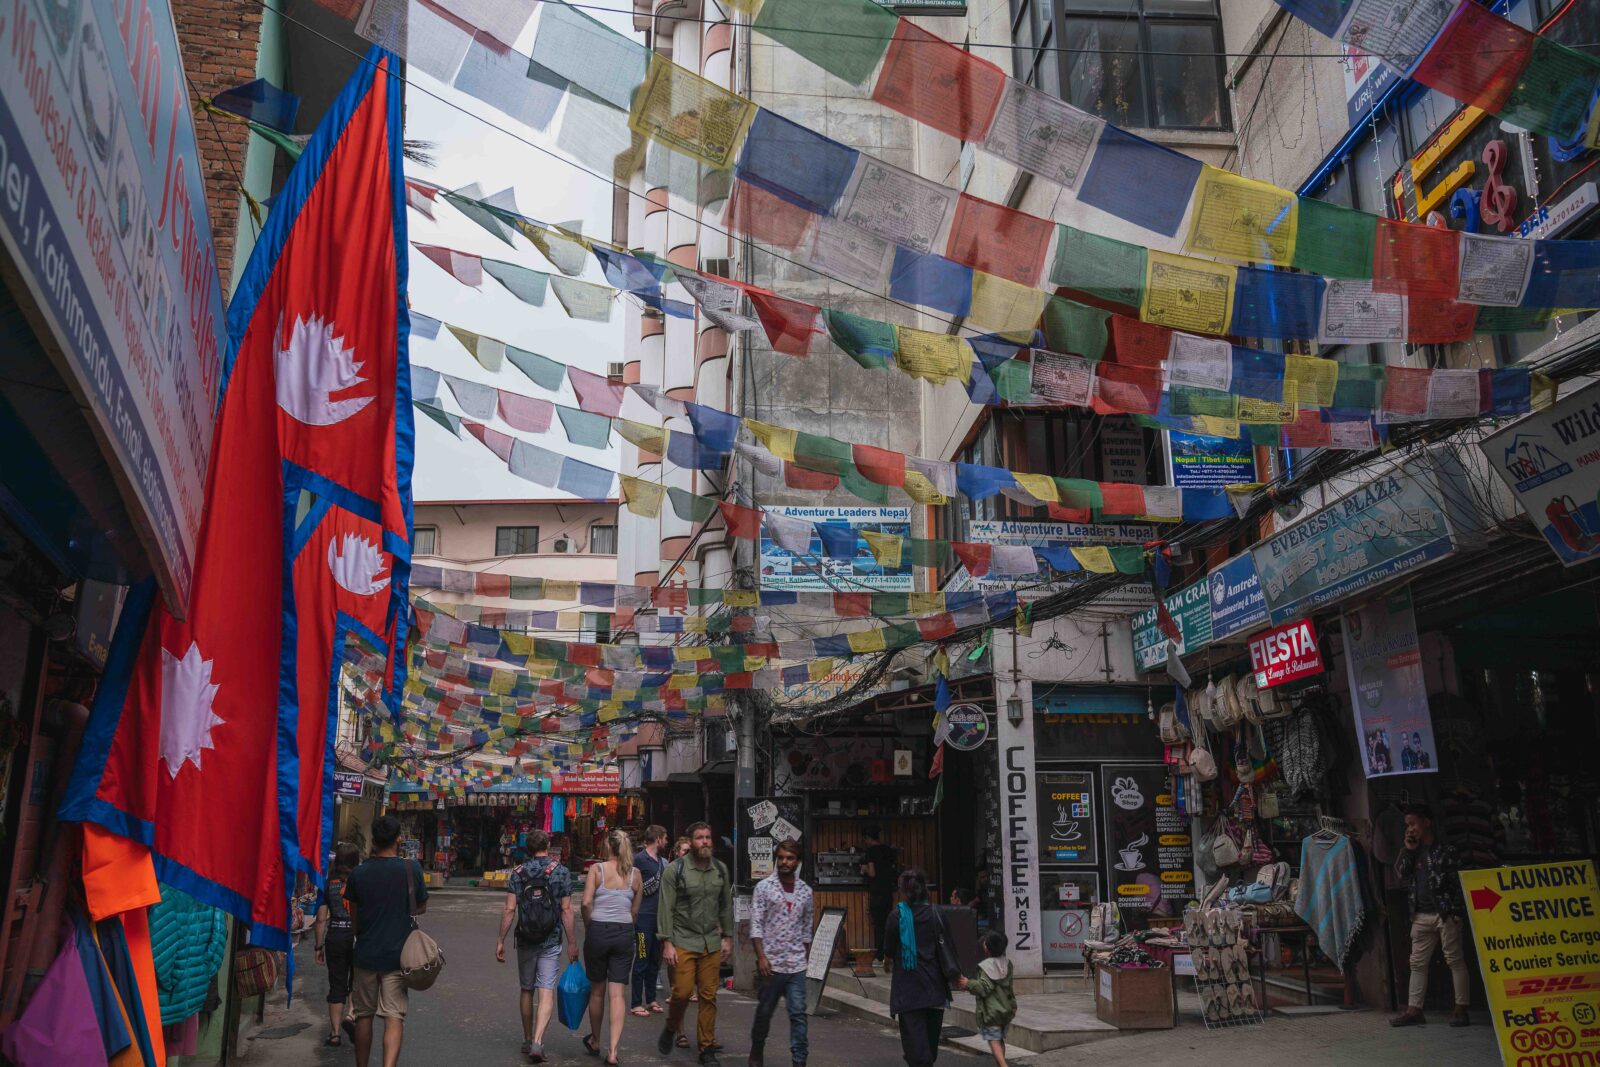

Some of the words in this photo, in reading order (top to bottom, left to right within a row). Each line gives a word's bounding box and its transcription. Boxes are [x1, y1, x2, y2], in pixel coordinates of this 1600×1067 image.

[1520, 205, 1550, 238] BAR
[35, 207, 114, 418] Kathmandu,
[1104, 447, 1142, 457] LEADERS
[1175, 456, 1197, 465] Nepal
[1110, 458, 1137, 467] NEPAL
[784, 507, 835, 517] Adventure
[838, 507, 877, 518] Leaders
[880, 508, 909, 519] Nepal
[1270, 508, 1338, 558] EVEREST
[1344, 476, 1404, 519] PLAZA
[1001, 522, 1064, 536] Adventure
[1067, 523, 1116, 538] Leaders
[1119, 525, 1154, 540] Nepal
[1265, 538, 1328, 602] EVEREST
[1332, 506, 1438, 553] SNOOKER
[1315, 548, 1369, 586] HOUSE
[1226, 574, 1259, 598] Amtrek
[1131, 614, 1145, 631] OM
[1249, 623, 1316, 671] FIESTA
[1051, 792, 1081, 800] COFFEE
[1118, 793, 1140, 801] Coffee
[1121, 799, 1138, 807] Shop
[748, 800, 771, 816] COFFEE
[1006, 746, 1029, 887] COFFEE
[1496, 864, 1587, 892] LAUNDRY
[1509, 896, 1595, 923] SERVICE
[1483, 932, 1557, 951] Worldwide
[1489, 958, 1501, 973] &
[1503, 954, 1553, 972] Courier
[1519, 975, 1592, 995] DHL
[1502, 1006, 1562, 1028] FedEx
[1576, 1007, 1591, 1019] SF
